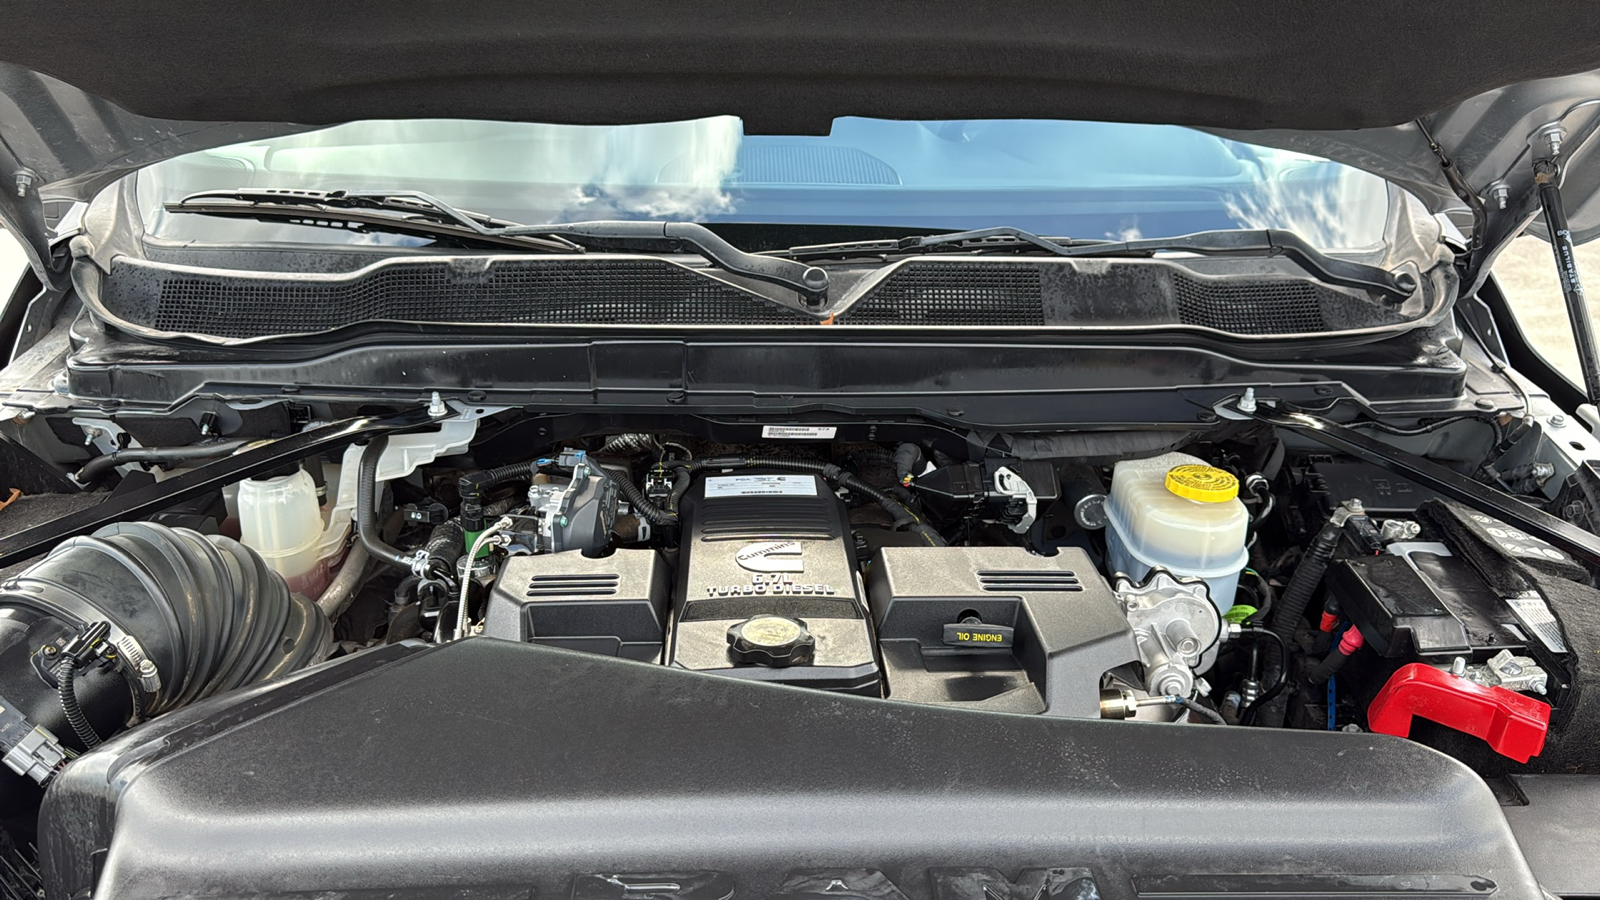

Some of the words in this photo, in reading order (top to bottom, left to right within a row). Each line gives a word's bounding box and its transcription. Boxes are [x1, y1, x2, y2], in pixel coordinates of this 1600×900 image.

[1562, 245, 1576, 284] STABILUS
[737, 541, 796, 561] Cummins
[752, 573, 793, 586] 6.7L
[706, 584, 767, 597] TURBO
[772, 583, 835, 595] DIESEL
[956, 632, 970, 641] OIL
[972, 633, 1003, 642] ENGINE
